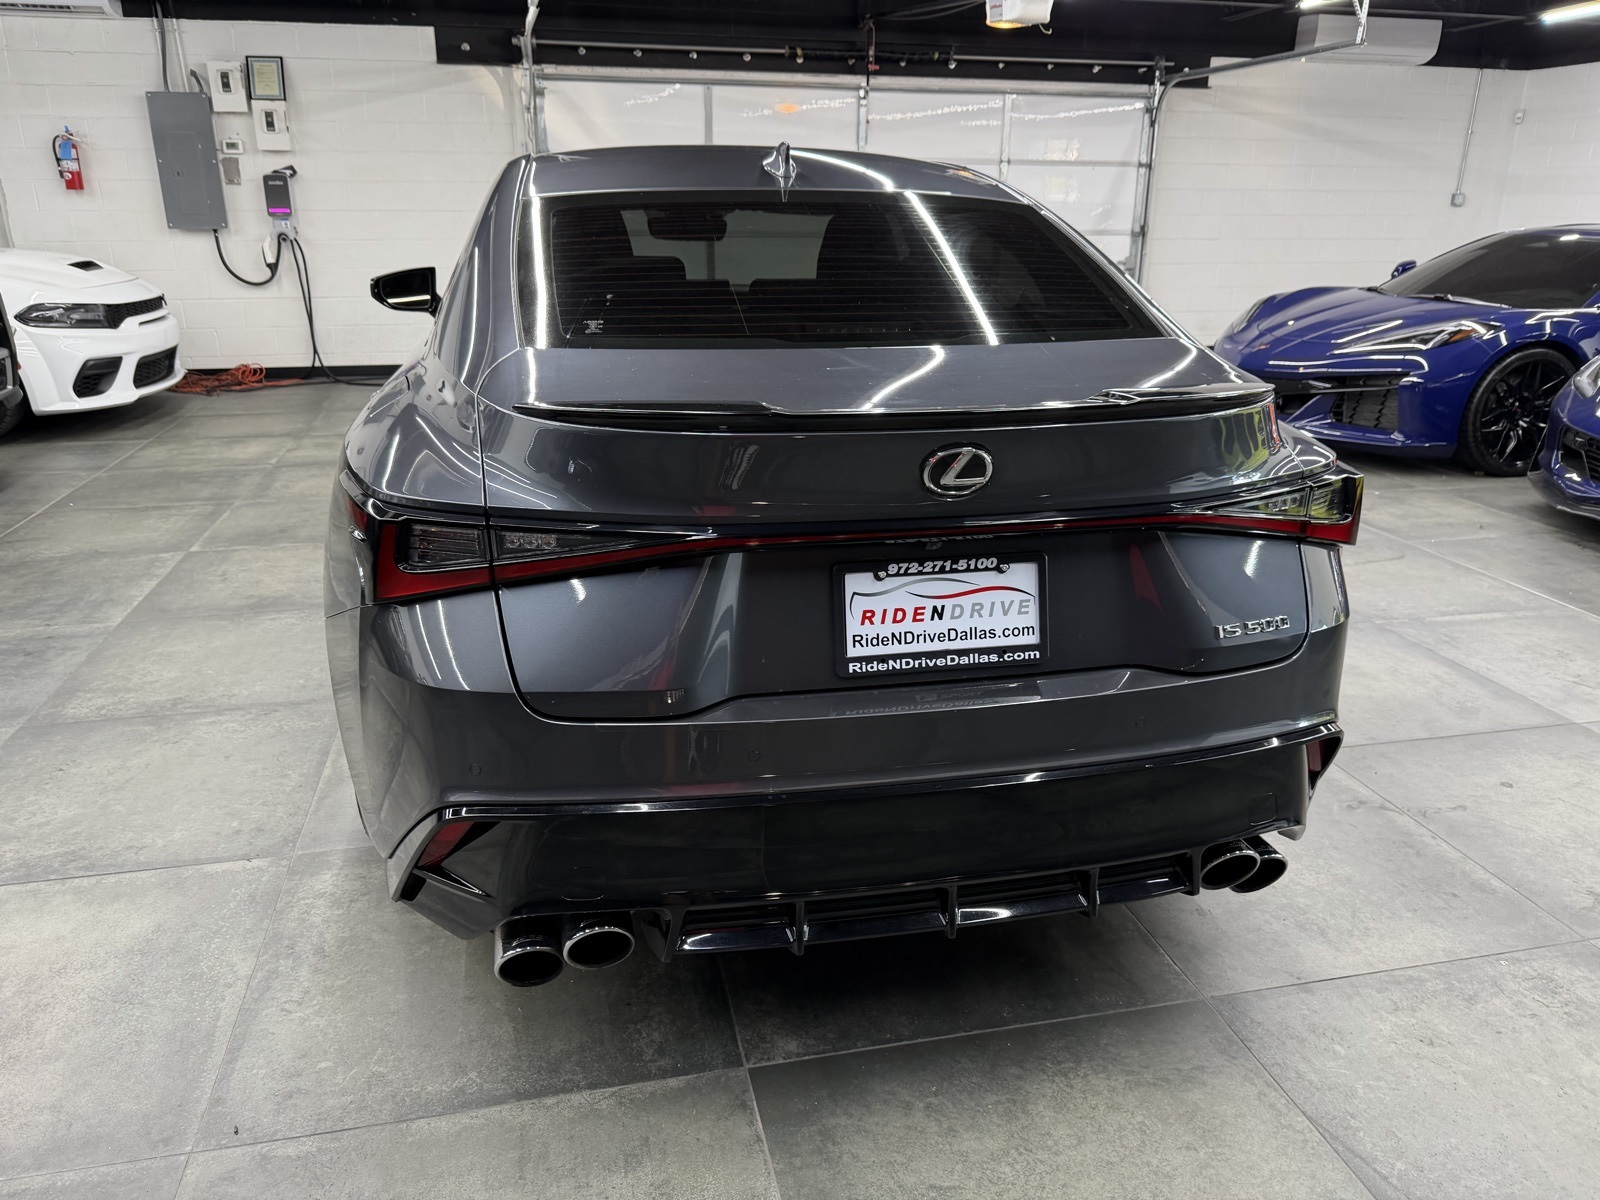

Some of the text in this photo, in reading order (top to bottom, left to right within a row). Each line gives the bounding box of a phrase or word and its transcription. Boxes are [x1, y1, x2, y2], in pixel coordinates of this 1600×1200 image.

[887, 557, 998, 575] 972-271-5100
[852, 625, 1035, 648] RideNDriveDallas.com
[1214, 615, 1290, 640] IS 500
[848, 651, 1040, 673] RideNDriveDallas.com
